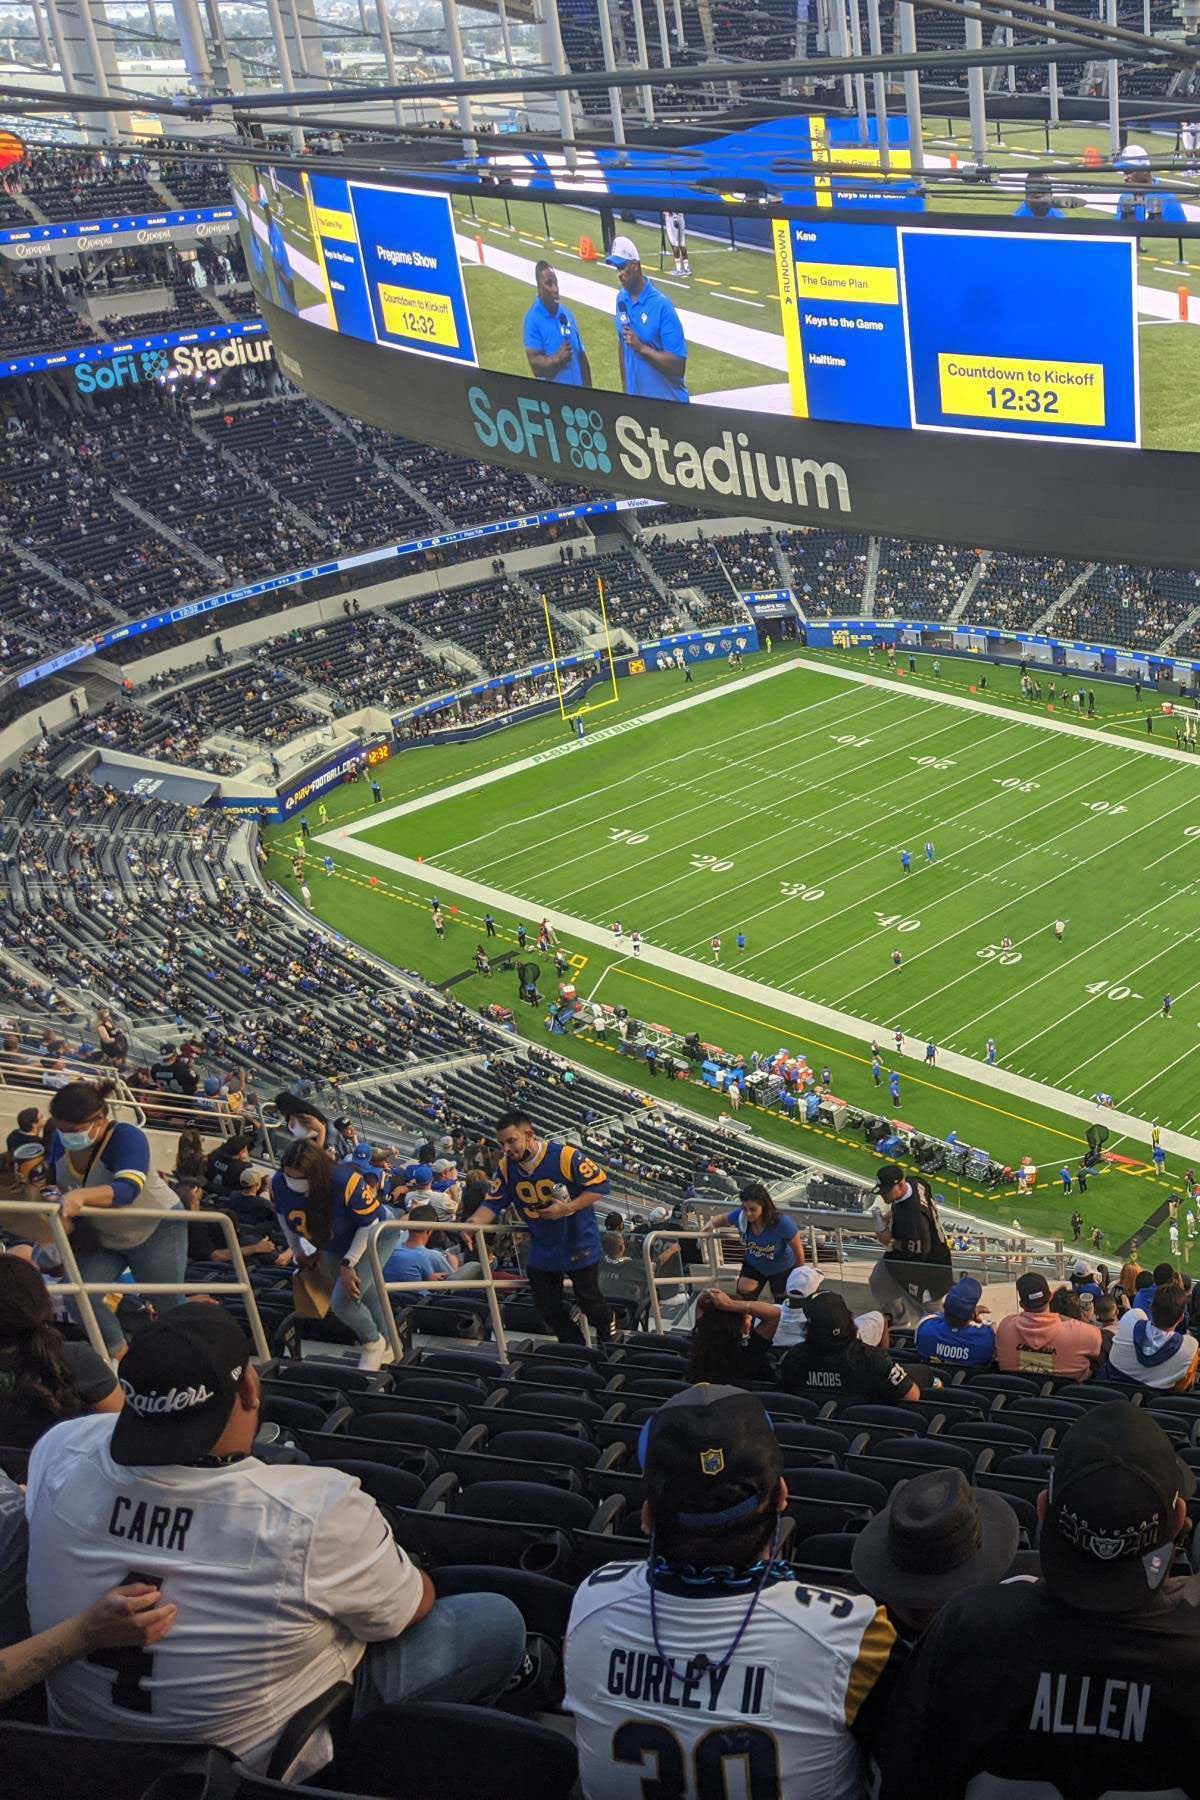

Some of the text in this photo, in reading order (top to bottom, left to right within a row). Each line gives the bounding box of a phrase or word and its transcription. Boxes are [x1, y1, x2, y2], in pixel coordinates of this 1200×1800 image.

[377, 245, 412, 266] Pregame
[413, 252, 437, 270] Show
[778, 229, 791, 293] RUNDOWN
[801, 275, 868, 288] The Game Plan
[384, 291, 448, 314] Countdown to Kickoff
[402, 312, 436, 336] 12:32
[805, 315, 884, 330] Keys to the Game
[809, 353, 846, 366] Halftime
[74, 355, 139, 393] SoFi
[947, 363, 1095, 386] Countdown to Kickoff
[986, 387, 1060, 414] 12:32
[467, 386, 852, 512] SoFi Stadium
[631, 661, 644, 674] 25
[976, 944, 1022, 965] 50
[936, 1343, 969, 1360] WOODS
[806, 1371, 842, 1387] JACOBS
[119, 1378, 214, 1419] Raiders
[108, 1495, 194, 1552] CARR
[607, 1648, 765, 1715] GURLEY II
[1028, 1672, 1151, 1742] ALLEN
